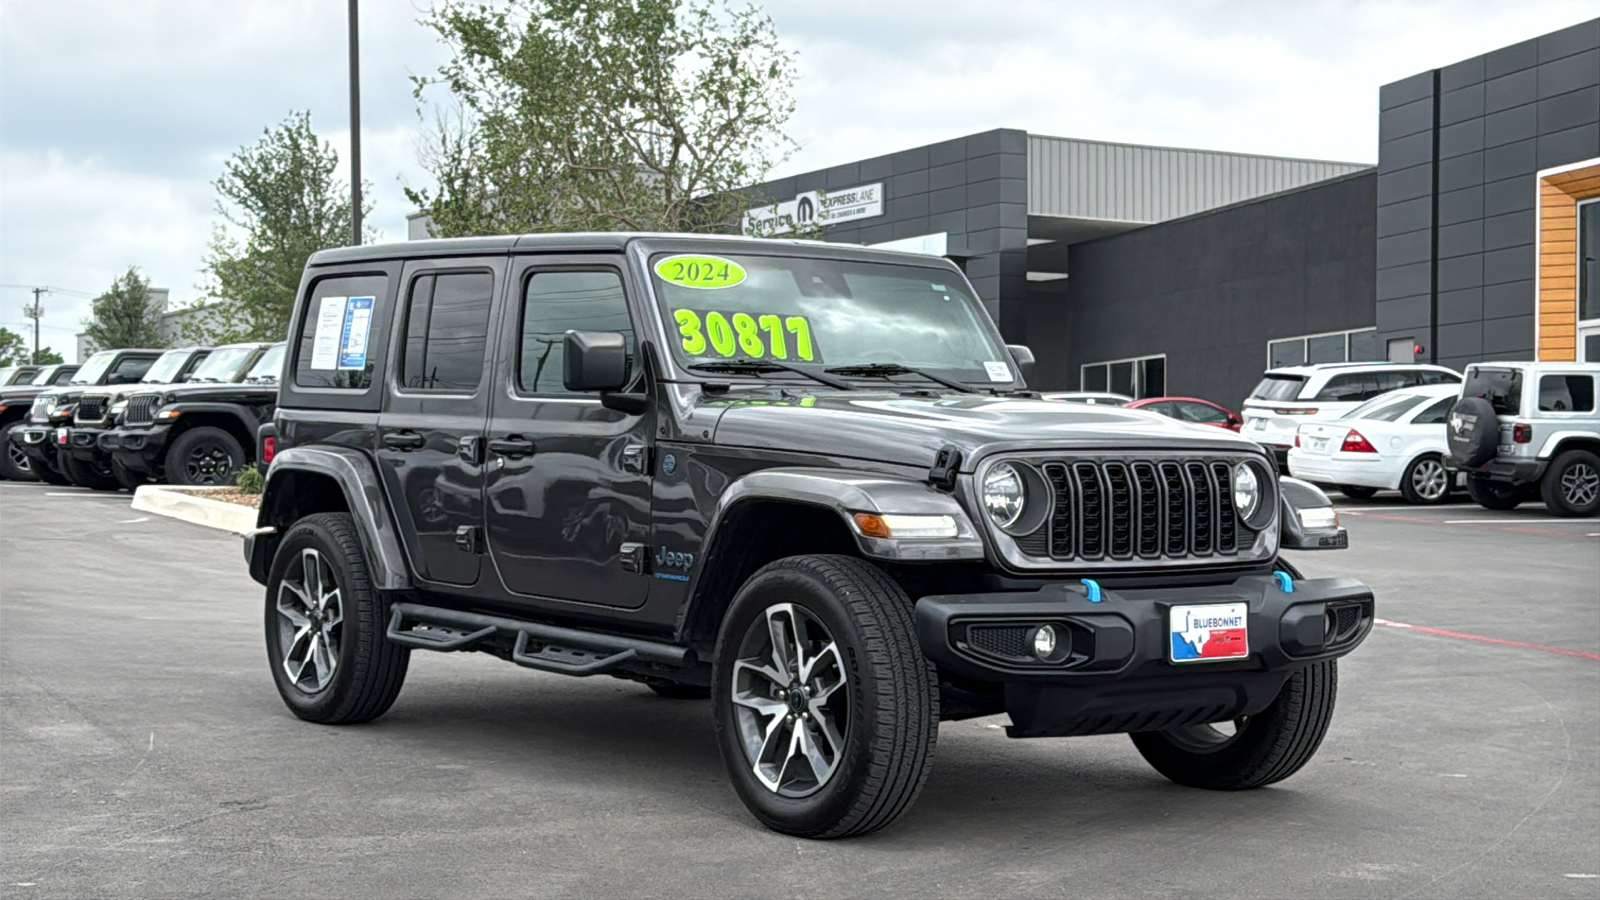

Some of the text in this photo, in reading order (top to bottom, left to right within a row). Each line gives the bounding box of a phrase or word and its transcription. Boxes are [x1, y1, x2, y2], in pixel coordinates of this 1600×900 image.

[748, 213, 793, 232] Service
[673, 262, 730, 281] 2024
[674, 309, 813, 361] 30877
[655, 545, 694, 572] Jeep
[1193, 616, 1242, 629] BLUEBONNET
